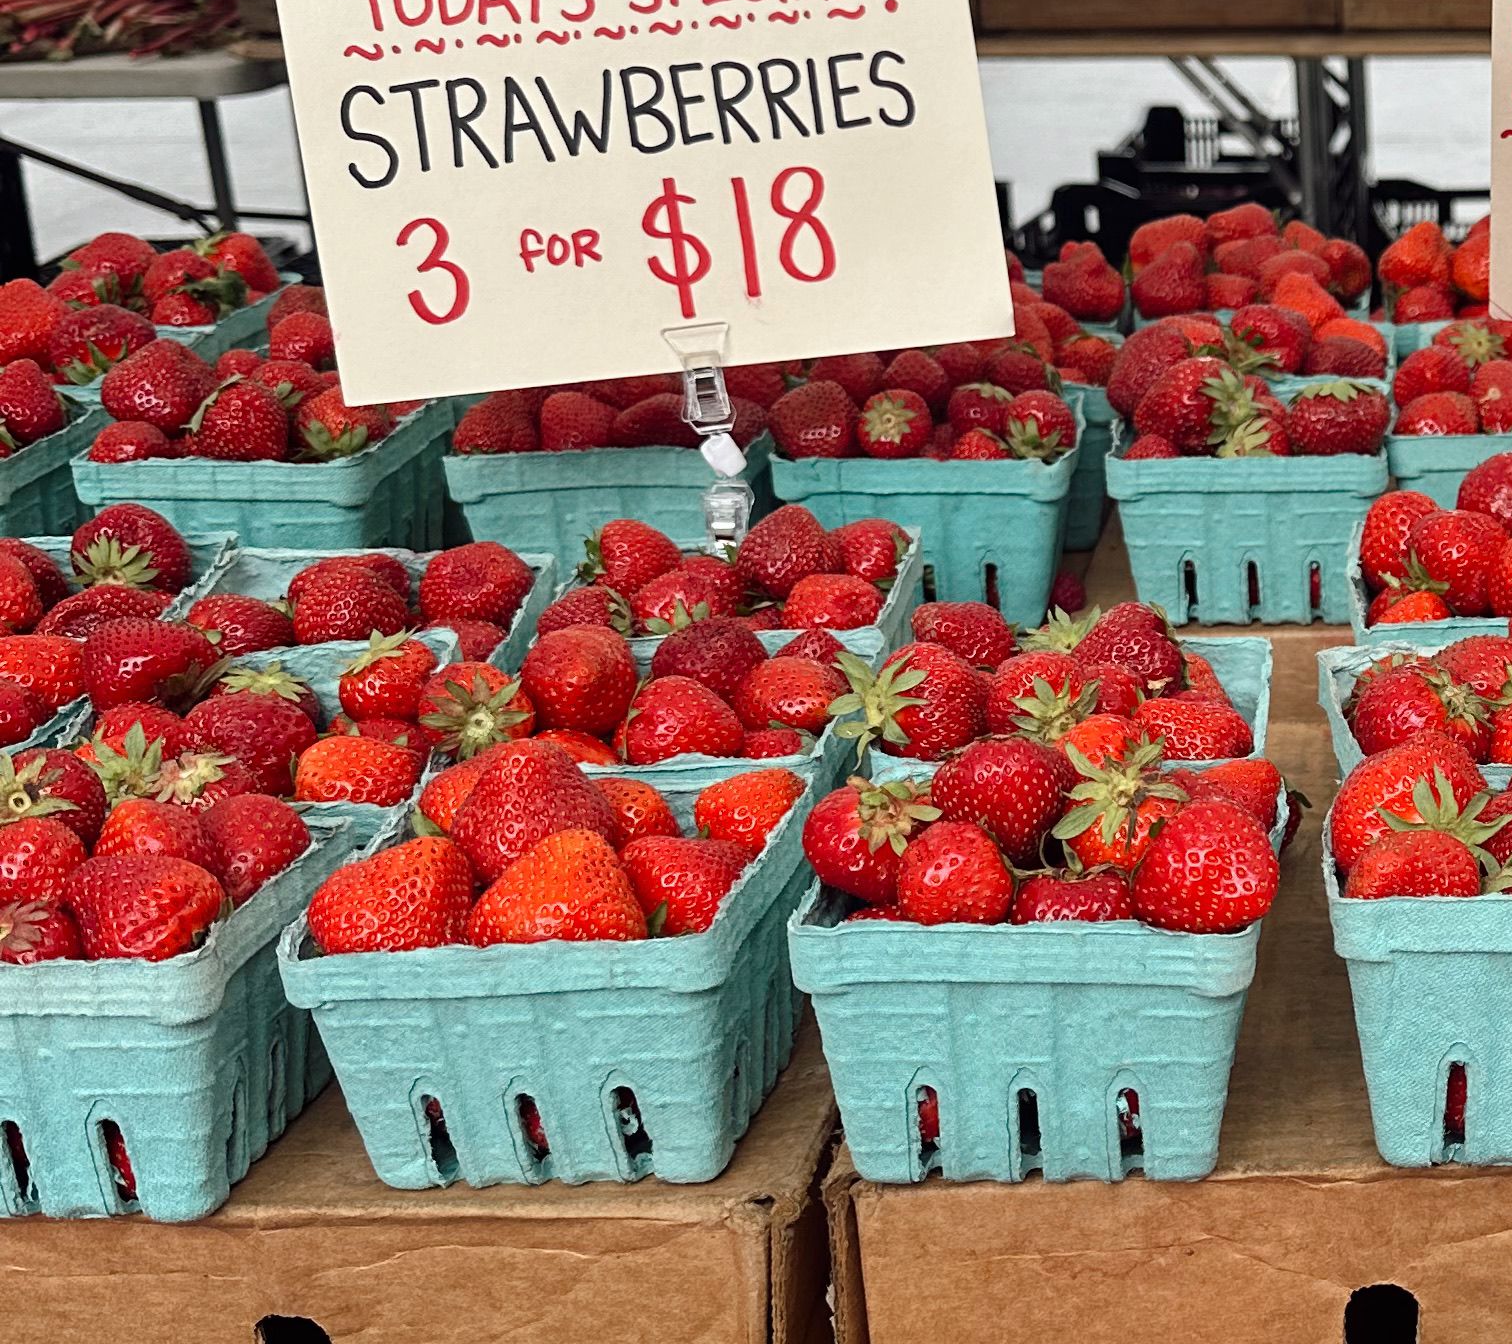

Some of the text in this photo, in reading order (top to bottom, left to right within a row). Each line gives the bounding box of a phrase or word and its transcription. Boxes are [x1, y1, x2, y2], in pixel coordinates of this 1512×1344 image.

[340, 50, 915, 189] STRAWBERRIES
[396, 217, 470, 325] 3
[641, 165, 836, 319] $18
